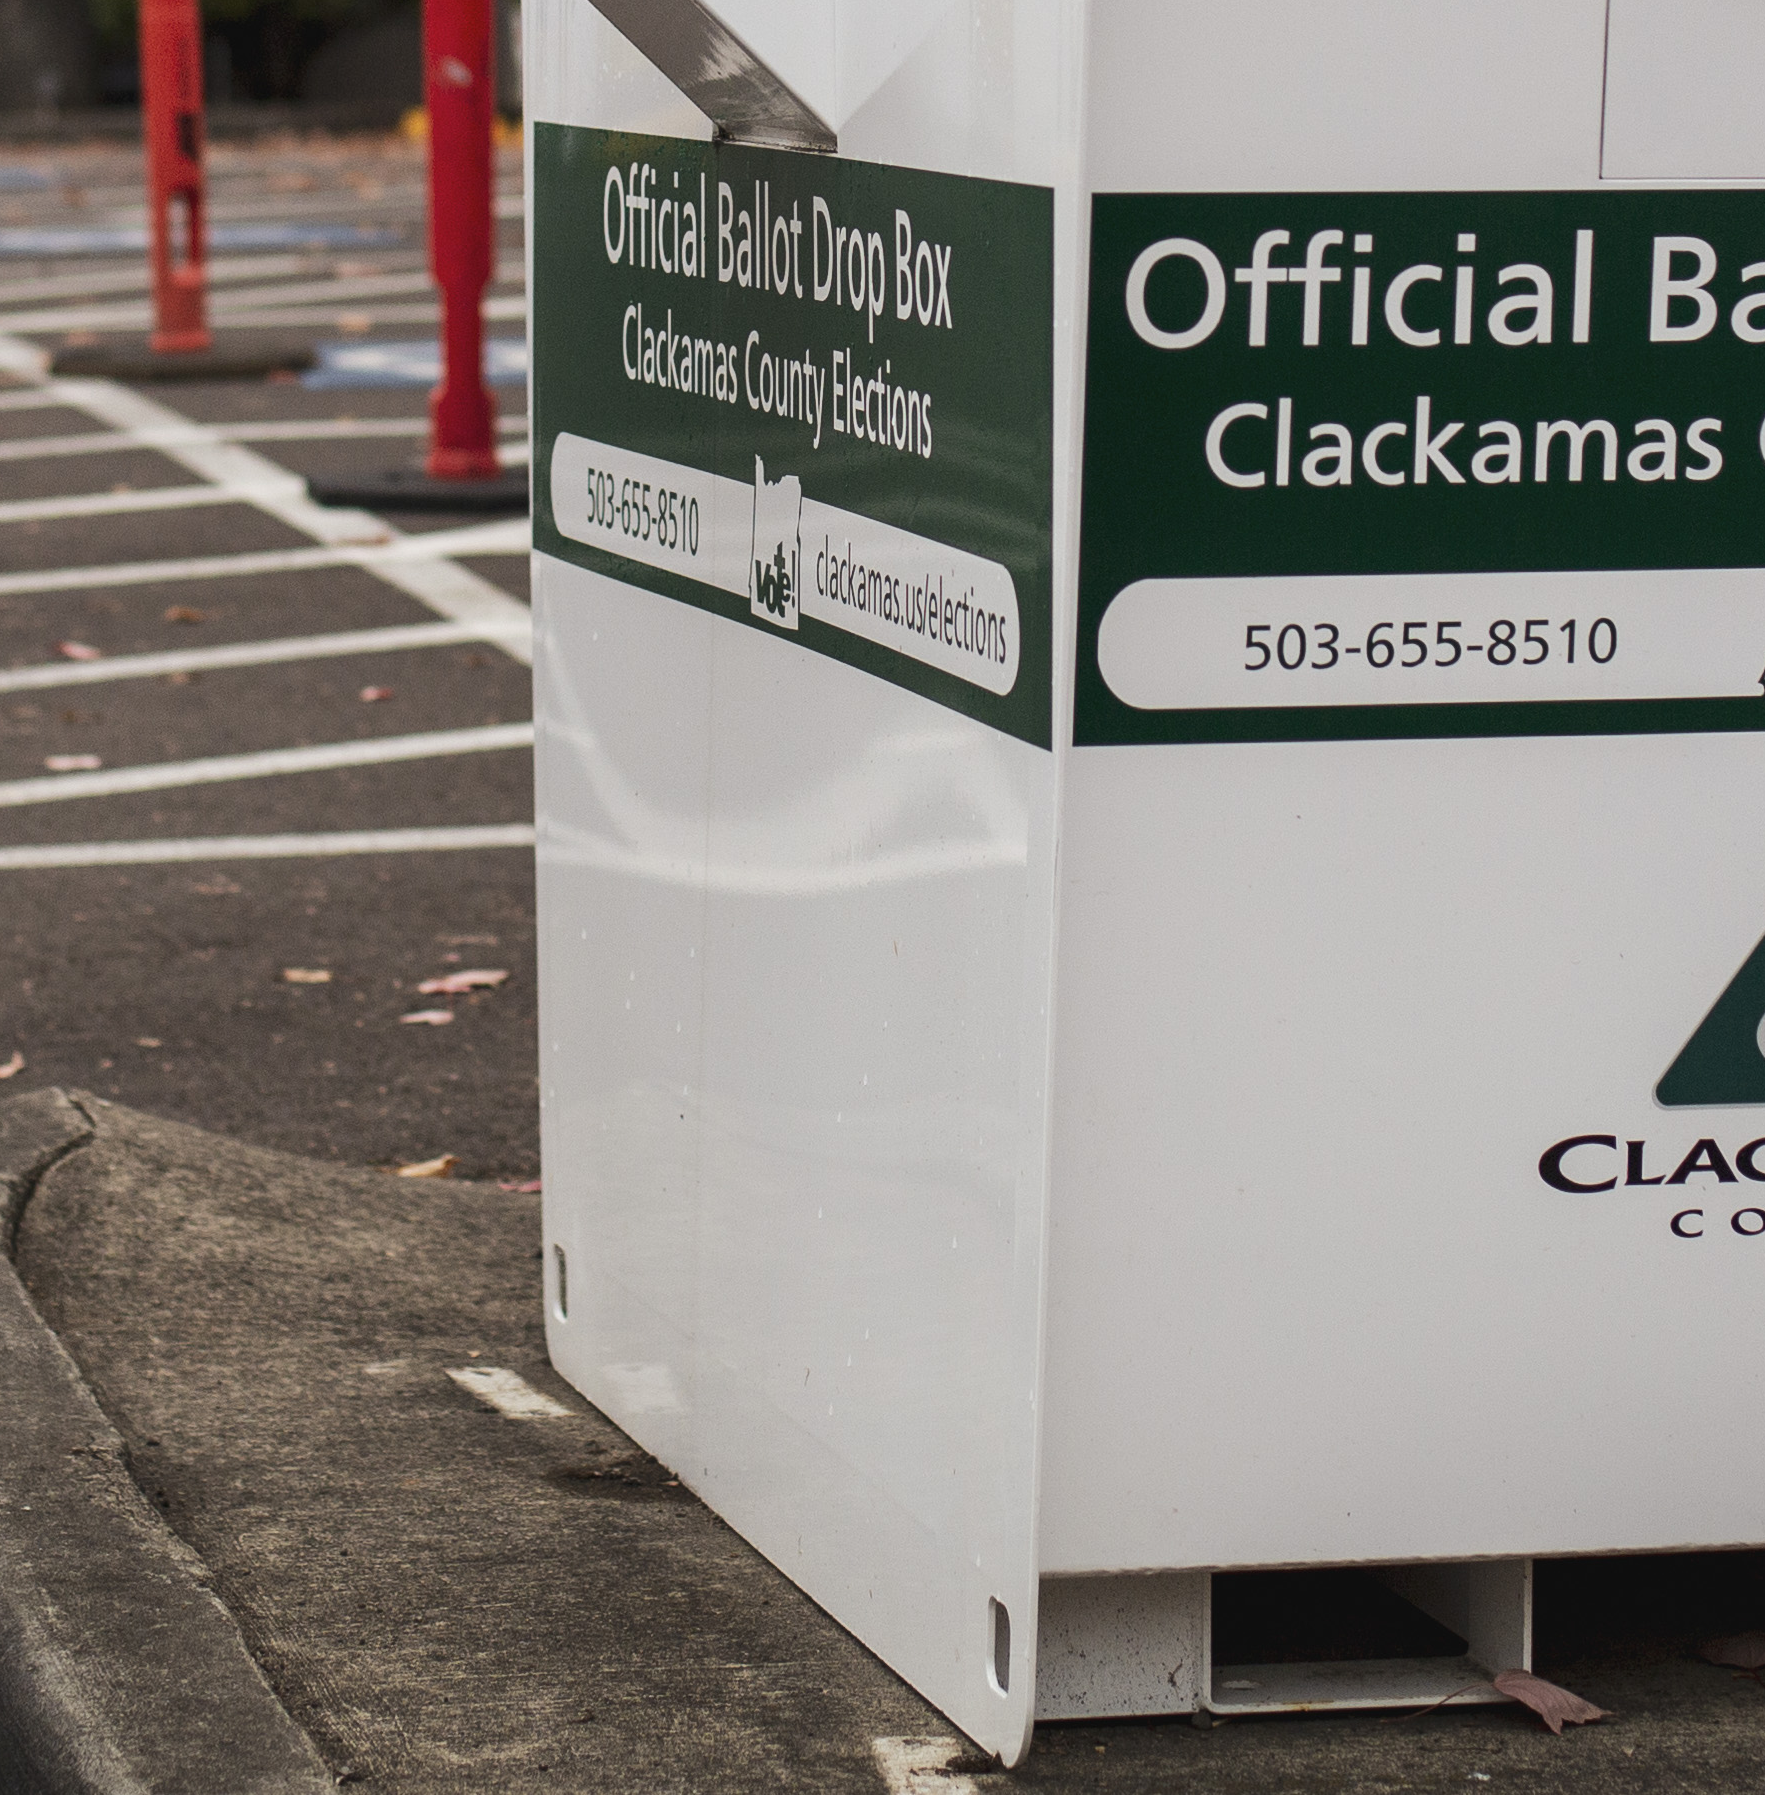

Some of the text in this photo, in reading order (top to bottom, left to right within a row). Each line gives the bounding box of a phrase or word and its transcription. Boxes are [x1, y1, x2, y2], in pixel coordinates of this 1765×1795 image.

[603, 161, 953, 344] Official Ballot Drop Box
[1125, 229, 1594, 350] Official
[622, 302, 932, 459] Clackamas County Elections
[1205, 395, 1723, 488] Clackamas
[586, 466, 701, 557] 503-655-8510
[755, 541, 797, 619] vote!
[815, 533, 1007, 665] clackamas.us/elections
[1244, 617, 1617, 671] 503-655-8510
